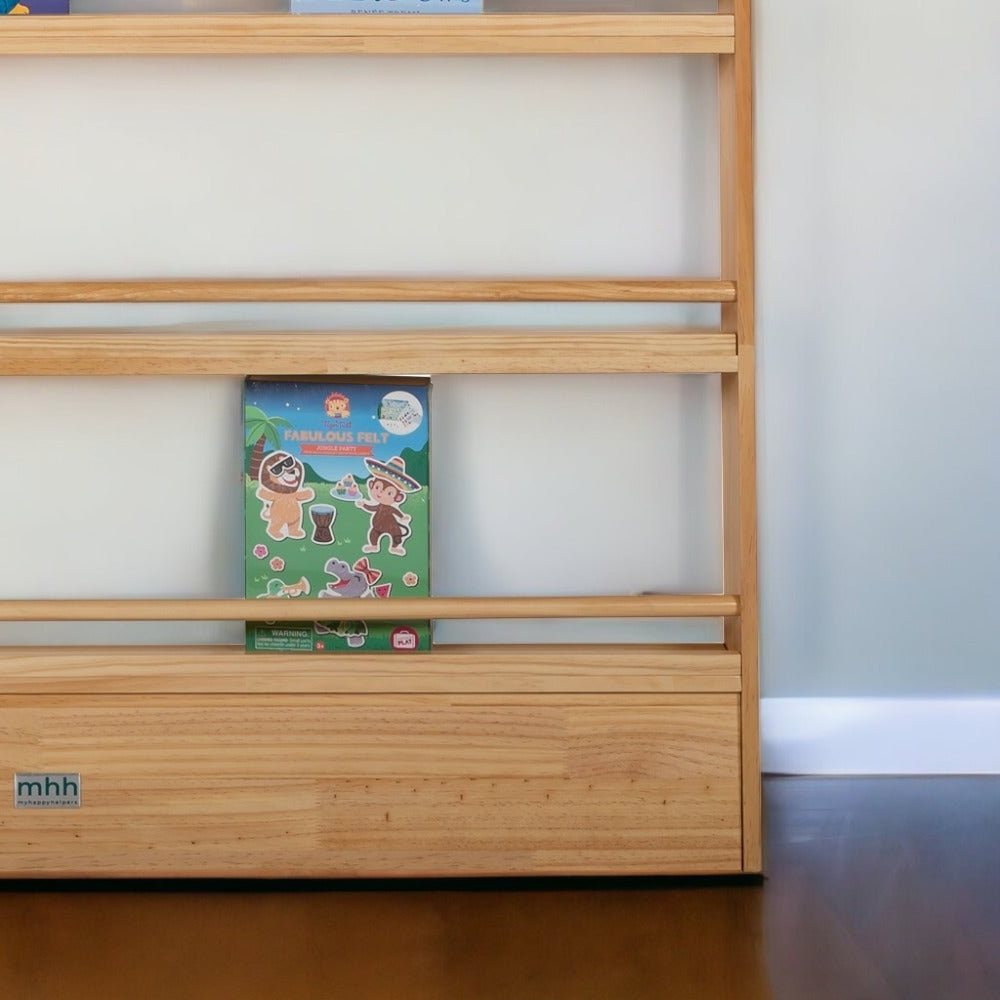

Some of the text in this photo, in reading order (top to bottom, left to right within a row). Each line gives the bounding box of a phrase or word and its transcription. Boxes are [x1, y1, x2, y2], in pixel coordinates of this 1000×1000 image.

[284, 430, 390, 443] FABULOUS FELT
[18, 776, 78, 796] mhh
